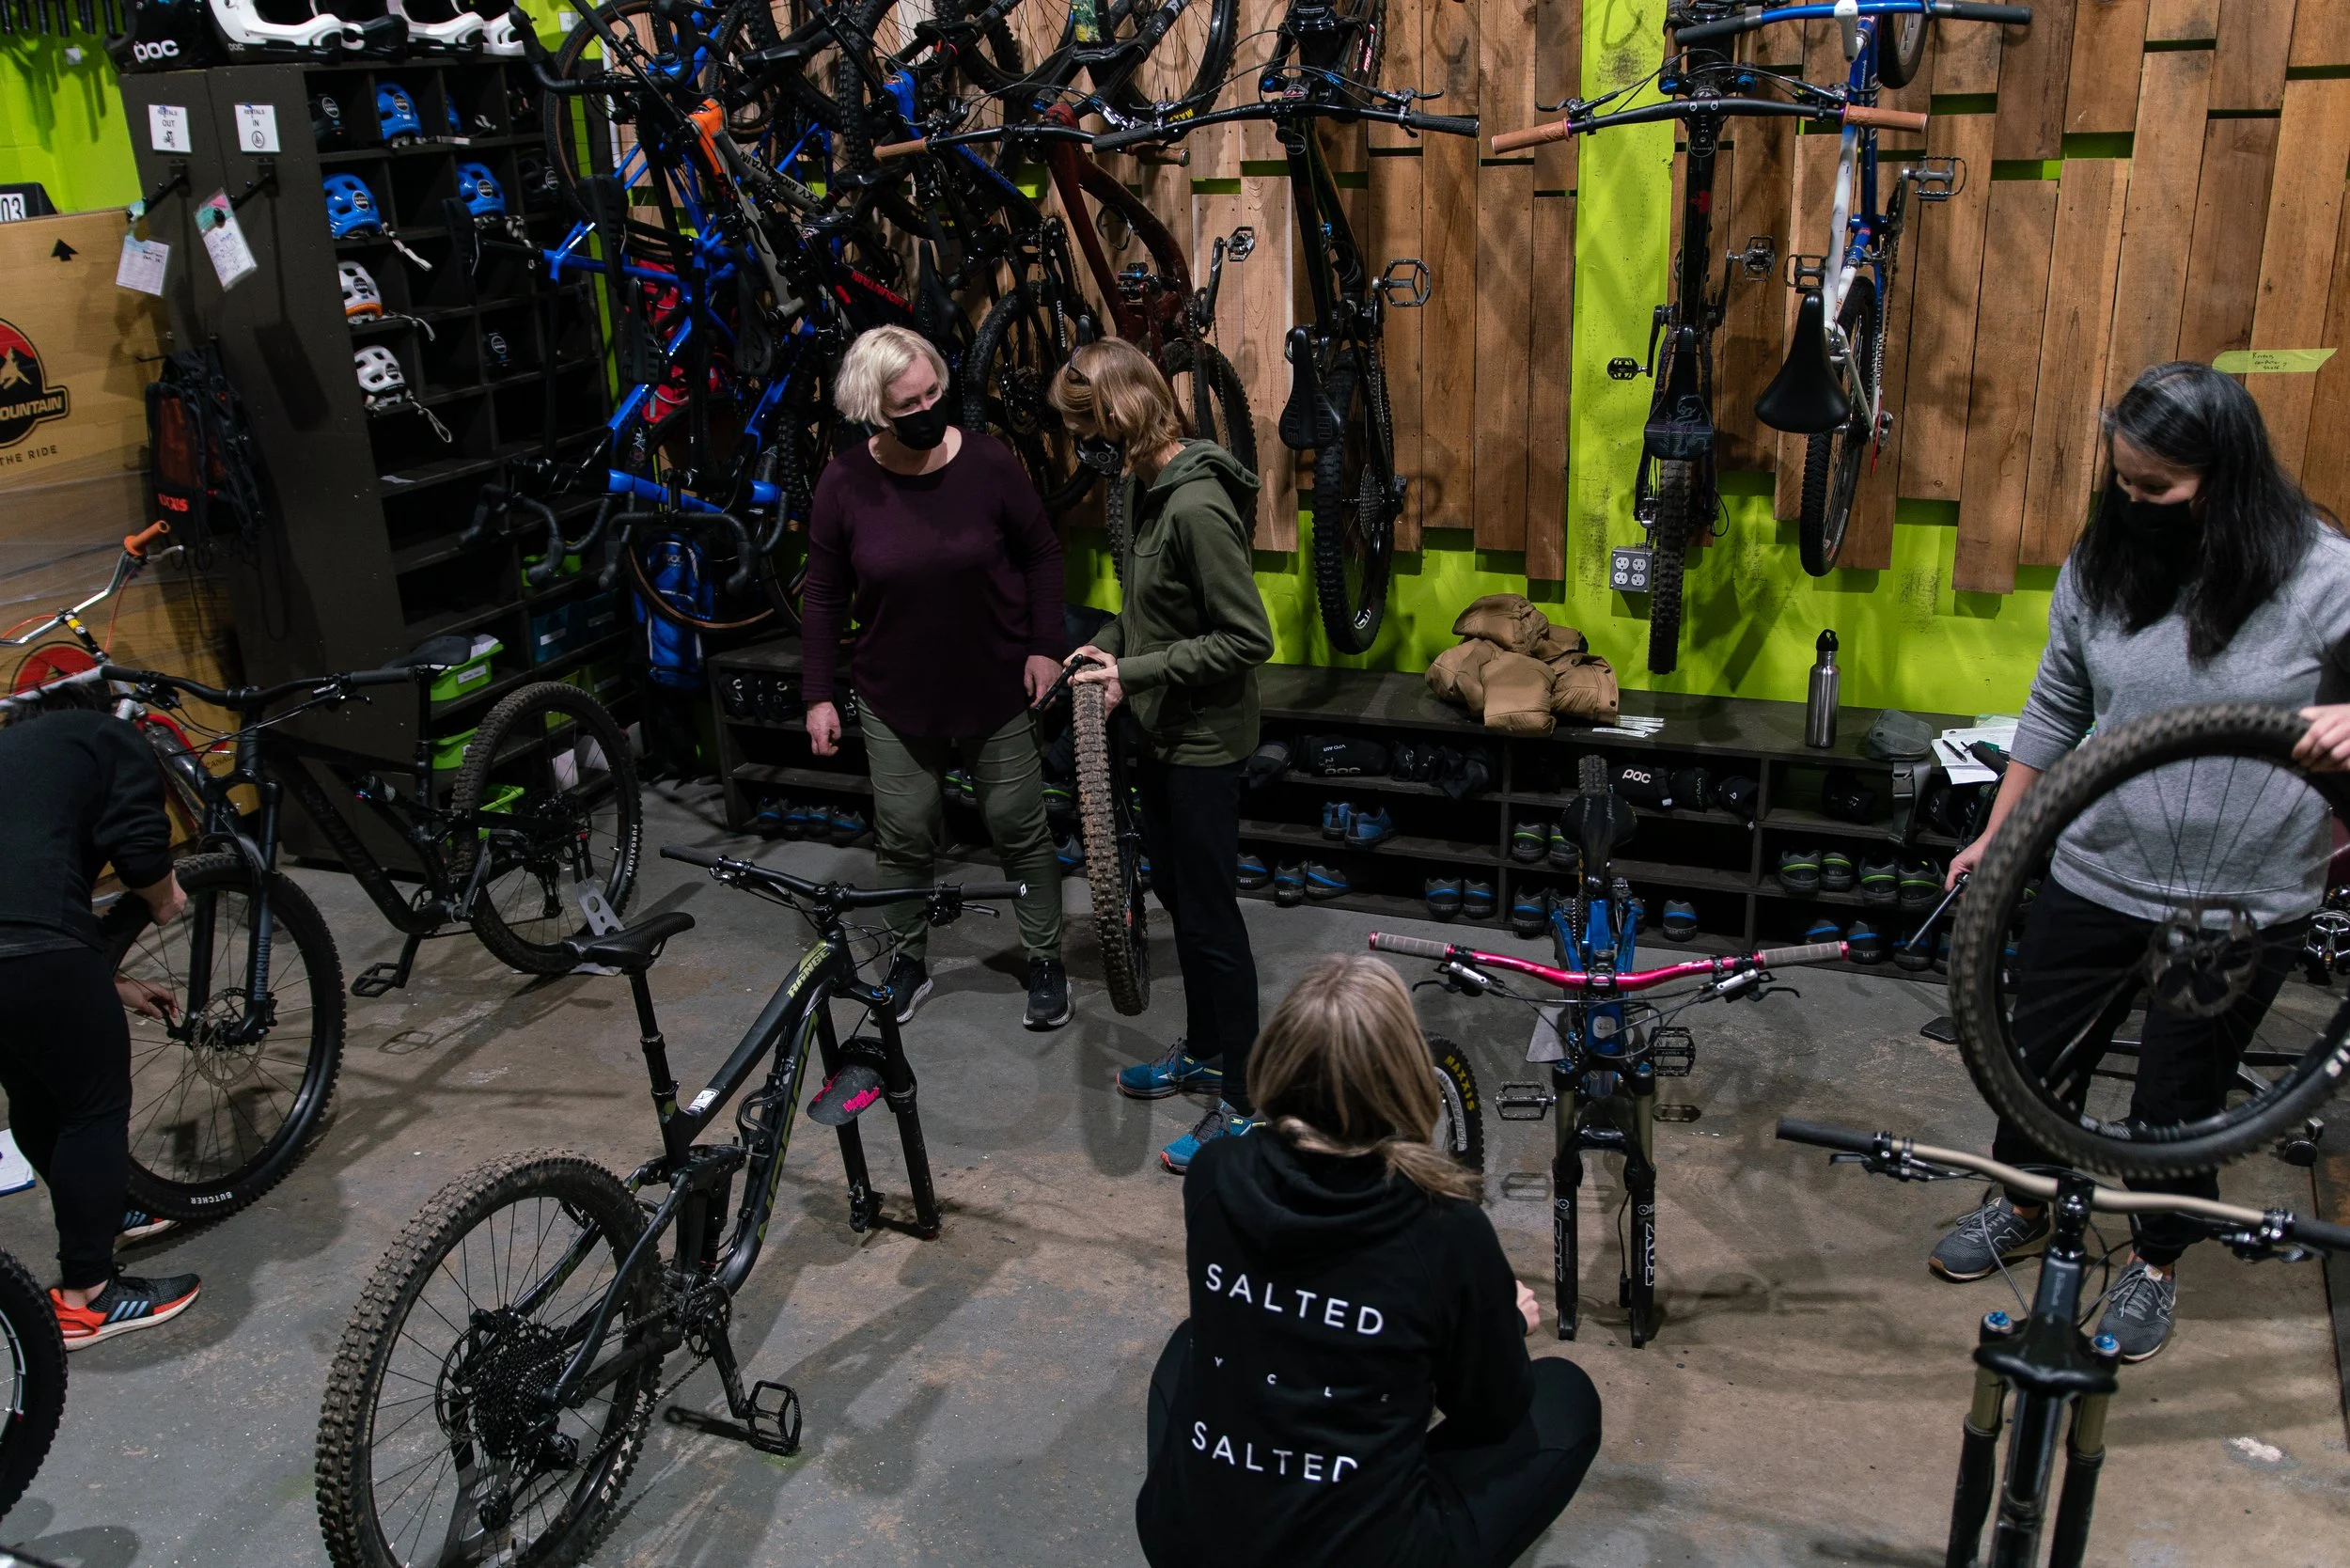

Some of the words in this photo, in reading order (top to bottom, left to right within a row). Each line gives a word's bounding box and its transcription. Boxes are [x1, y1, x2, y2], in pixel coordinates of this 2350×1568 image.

[740, 151, 798, 192] MONTAIN
[798, 189, 821, 204] CKY
[0, 396, 62, 420] OUNTAIN
[0, 456, 23, 466] THE
[28, 446, 57, 460] RIDE
[626, 823, 638, 877] PURGATORY
[786, 948, 830, 999] RANGE
[1444, 1055, 1475, 1111] MAXXIS
[190, 1191, 233, 1204] BUTCHER
[1206, 1263, 1384, 1335] SALTED
